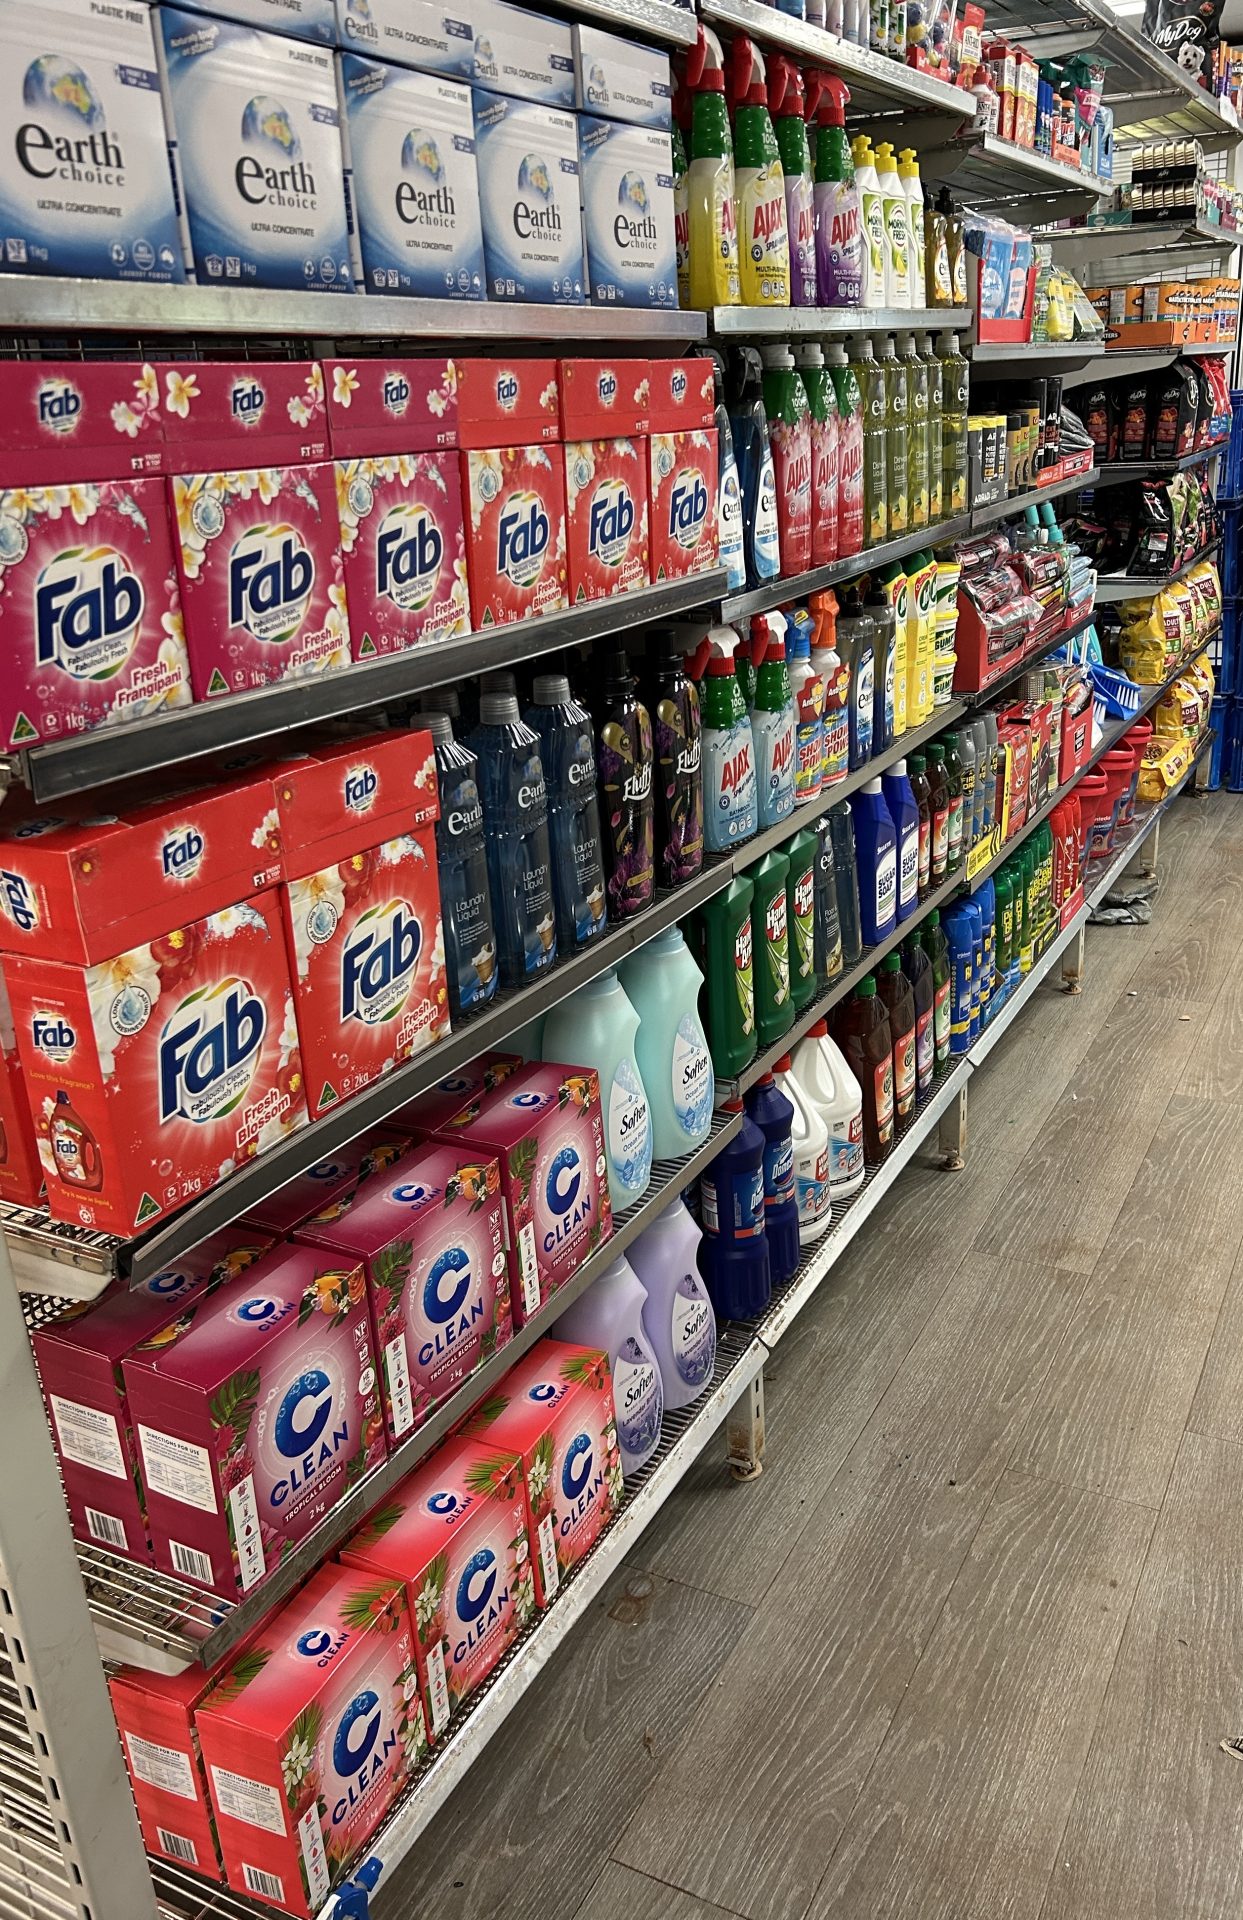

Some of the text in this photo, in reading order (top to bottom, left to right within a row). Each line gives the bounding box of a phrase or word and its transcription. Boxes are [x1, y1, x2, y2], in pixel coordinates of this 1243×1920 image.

[91, 3, 144, 24] PLASTIC FREE
[345, 16, 378, 39] earth
[1155, 20, 1202, 47] MyDog
[289, 50, 328, 68] PLASTIC FREE
[474, 60, 498, 78] earth
[588, 86, 609, 104] earth
[16, 123, 124, 178] earth
[59, 164, 125, 186] choice
[235, 155, 316, 205] earth
[37, 200, 121, 217] ULTRA CONCENTRATE
[267, 190, 317, 211] choice
[396, 182, 455, 224] earth
[251, 222, 314, 237] ULTRA CONCENTRATE
[419, 212, 455, 229] choice
[513, 202, 561, 238] earth
[614, 214, 656, 247] earth
[753, 197, 783, 243] AJAX
[831, 207, 858, 249] AJAX
[406, 240, 453, 252] ULTRA CONCENTRATE
[532, 228, 561, 241] choice
[630, 239, 657, 249] choice
[243, 263, 256, 276] 1kg
[534, 254, 559, 262] CONCENTRATE
[632, 261, 654, 269] CONCENTRATE
[401, 275, 410, 285] 1kg
[384, 379, 409, 404] Fab
[497, 379, 517, 400] Fab
[600, 376, 615, 397] Fab
[672, 376, 686, 395] Fab
[40, 389, 80, 423] Fab
[232, 385, 264, 416] Fab
[669, 479, 707, 536] Fab
[590, 491, 633, 552] Fab
[499, 505, 548, 572] Fab
[698, 542, 711, 555] Fresh
[378, 518, 441, 595] Fab
[623, 557, 639, 573] Fresh
[694, 552, 714, 567] Blossom
[230, 539, 314, 624] Fab
[538, 578, 555, 594] Fresh
[619, 568, 643, 587] Blossom
[436, 599, 457, 615] Fresh
[534, 589, 561, 610] Blossom
[37, 562, 142, 663] Fab
[425, 605, 465, 633] Frangipani
[508, 609, 517, 622] 1kg
[304, 628, 332, 649] Fresh
[393, 636, 405, 649] 1kg
[67, 648, 102, 666] Fabulously
[75, 647, 128, 673] Fabulously Fresh
[292, 635, 343, 667] Frangipani
[133, 663, 167, 686] Fresh
[251, 671, 266, 685] 1kg
[118, 669, 182, 706] Frangipani
[66, 714, 85, 730] 1kg
[677, 738, 702, 775] Fluffy
[721, 744, 750, 792] AJAX
[346, 770, 376, 806] Fab
[623, 763, 652, 801] Fluffy
[448, 800, 483, 835] earth
[163, 832, 202, 875] Fab
[574, 837, 598, 855] Laundry
[575, 850, 593, 865] Liquid
[902, 848, 917, 868] SUGAR
[903, 861, 916, 878] SOAP
[523, 863, 548, 883] Laundry
[524, 877, 544, 892] Liquid
[878, 867, 895, 889] SUGAR
[1, 870, 35, 931] Fab
[456, 892, 486, 913] Laundry
[878, 884, 892, 899] SOAP
[457, 905, 480, 923] Liquid
[342, 912, 421, 1022] Fab
[403, 1001, 429, 1027] Fresh
[34, 1020, 75, 1048] Fab
[398, 1009, 437, 1047] Blossom
[161, 990, 264, 1120] Fab
[30, 1071, 94, 1090] Love this fragrance?
[354, 1072, 369, 1088] 2kg
[191, 1083, 226, 1114] Fabulously
[199, 1074, 250, 1116] Fabulously Fresh
[244, 1089, 278, 1123] Fresh
[532, 1093, 557, 1113] CLEAN
[238, 1096, 290, 1145] Blossom
[57, 1140, 77, 1154] Fab
[182, 1178, 201, 1197] 2kg
[411, 1188, 442, 1210] CLEAN
[544, 1194, 591, 1252] CLEAN
[258, 1302, 296, 1332] CLEAN
[419, 1298, 484, 1366] CLEAN
[430, 1337, 478, 1382] TROPICAL BLOOM
[681, 1340, 702, 1359] Lavender
[548, 1385, 569, 1408] CLEAN
[57, 1400, 108, 1423] DIRECTIONS FOR USE
[622, 1398, 647, 1427] Lavender
[146, 1431, 200, 1456] DIRECTIONS FOR USE
[270, 1422, 349, 1507] CLEAN
[285, 1466, 342, 1522] TROPICAL BLOOM
[561, 1471, 603, 1537] CLEAN
[445, 1496, 473, 1524] CLEAN
[454, 1588, 509, 1664] CLEAN
[317, 1633, 350, 1667] CLEAN
[218, 1769, 270, 1792] DIRECTIONS FOR USE
[332, 1729, 397, 1825] CLEAN
